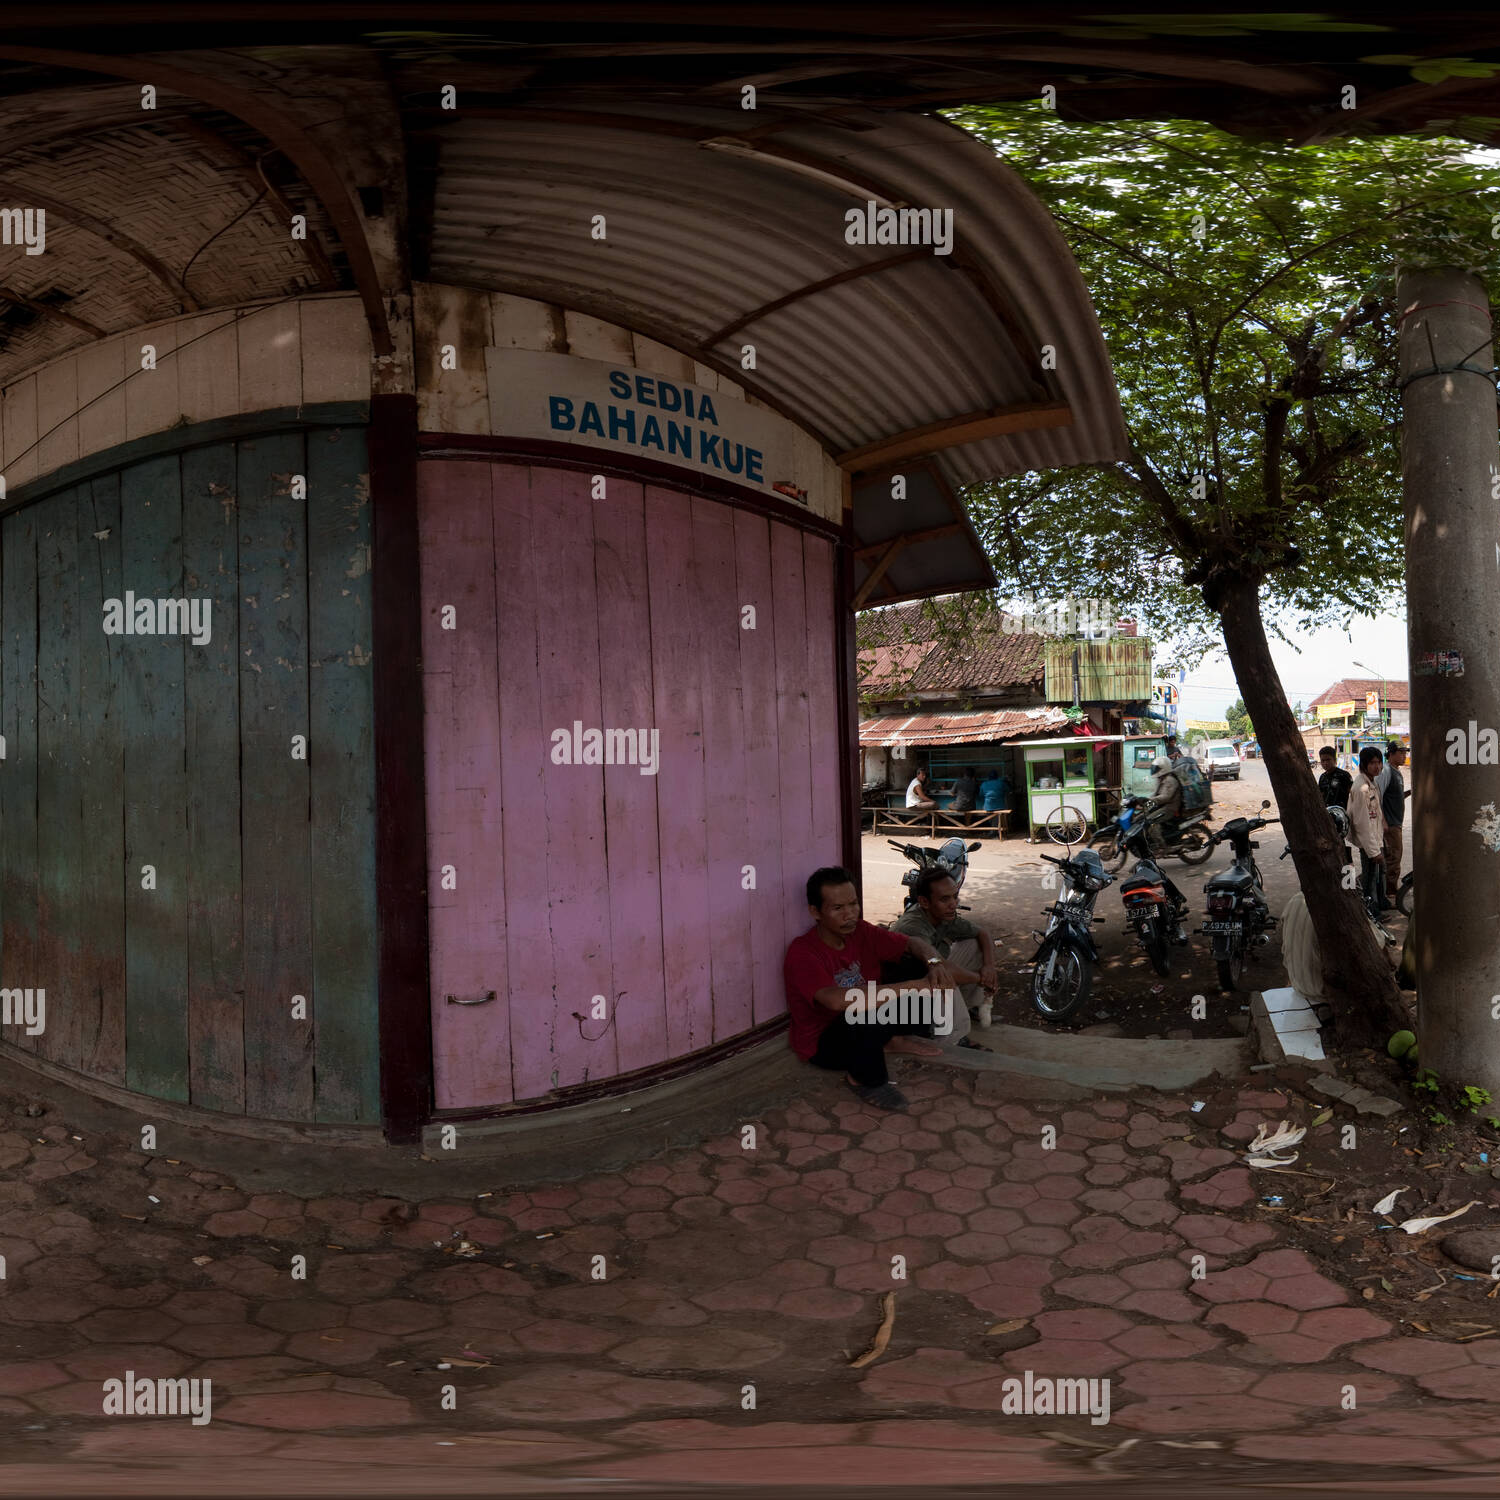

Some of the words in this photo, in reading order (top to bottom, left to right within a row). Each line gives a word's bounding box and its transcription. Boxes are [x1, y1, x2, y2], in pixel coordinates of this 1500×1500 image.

[609, 370, 719, 426] SEDIA
[548, 395, 692, 459] BAHAN
[700, 430, 765, 484] KUE
